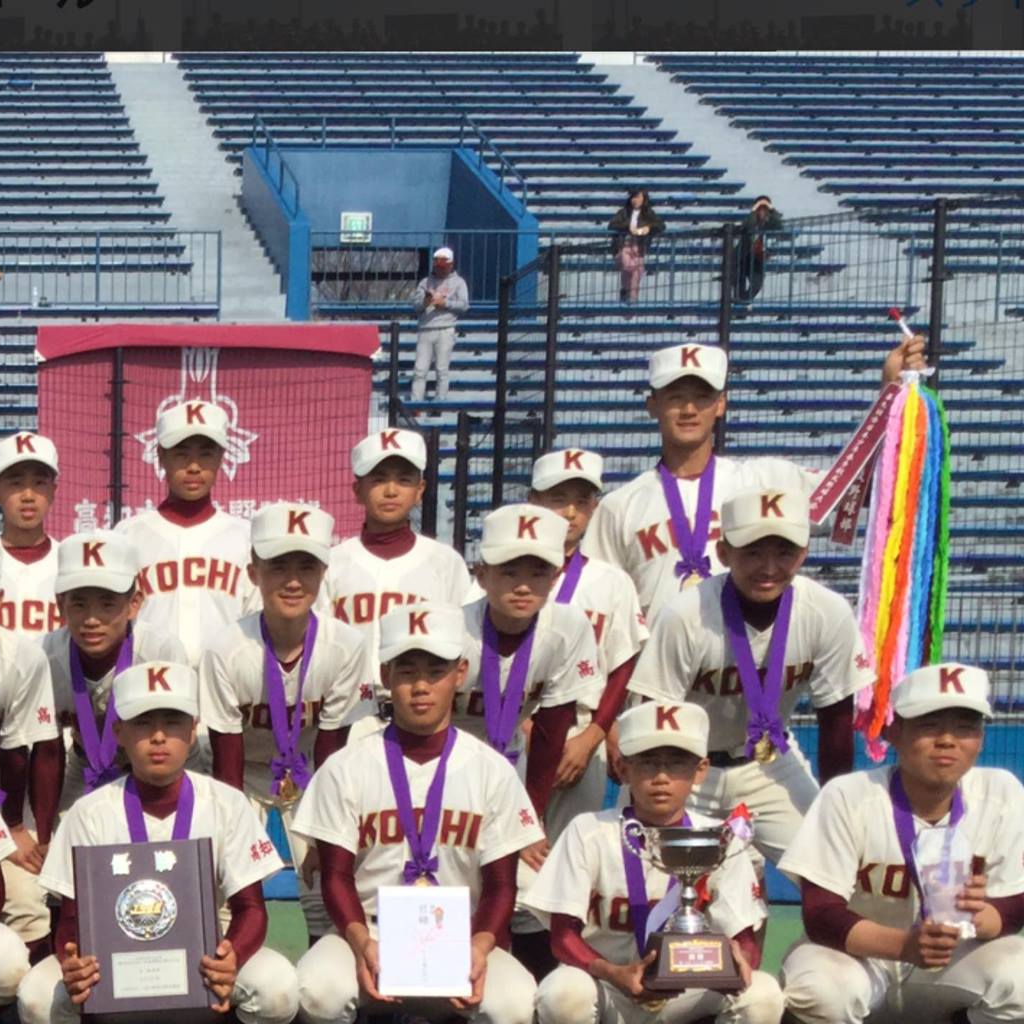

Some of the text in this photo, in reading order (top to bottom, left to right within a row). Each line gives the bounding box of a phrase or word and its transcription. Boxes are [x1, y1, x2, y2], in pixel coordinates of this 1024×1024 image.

[680, 347, 701, 368] K
[186, 403, 206, 425] K
[15, 434, 36, 454] K
[380, 430, 401, 451] K
[564, 450, 584, 470] K
[760, 493, 784, 518] K
[287, 510, 311, 535] K
[517, 515, 541, 540] K
[82, 541, 105, 567] K
[136, 556, 242, 598] KOCHI
[408, 611, 429, 635] K
[147, 666, 171, 692] K
[939, 667, 965, 694] K
[655, 705, 680, 731] K
